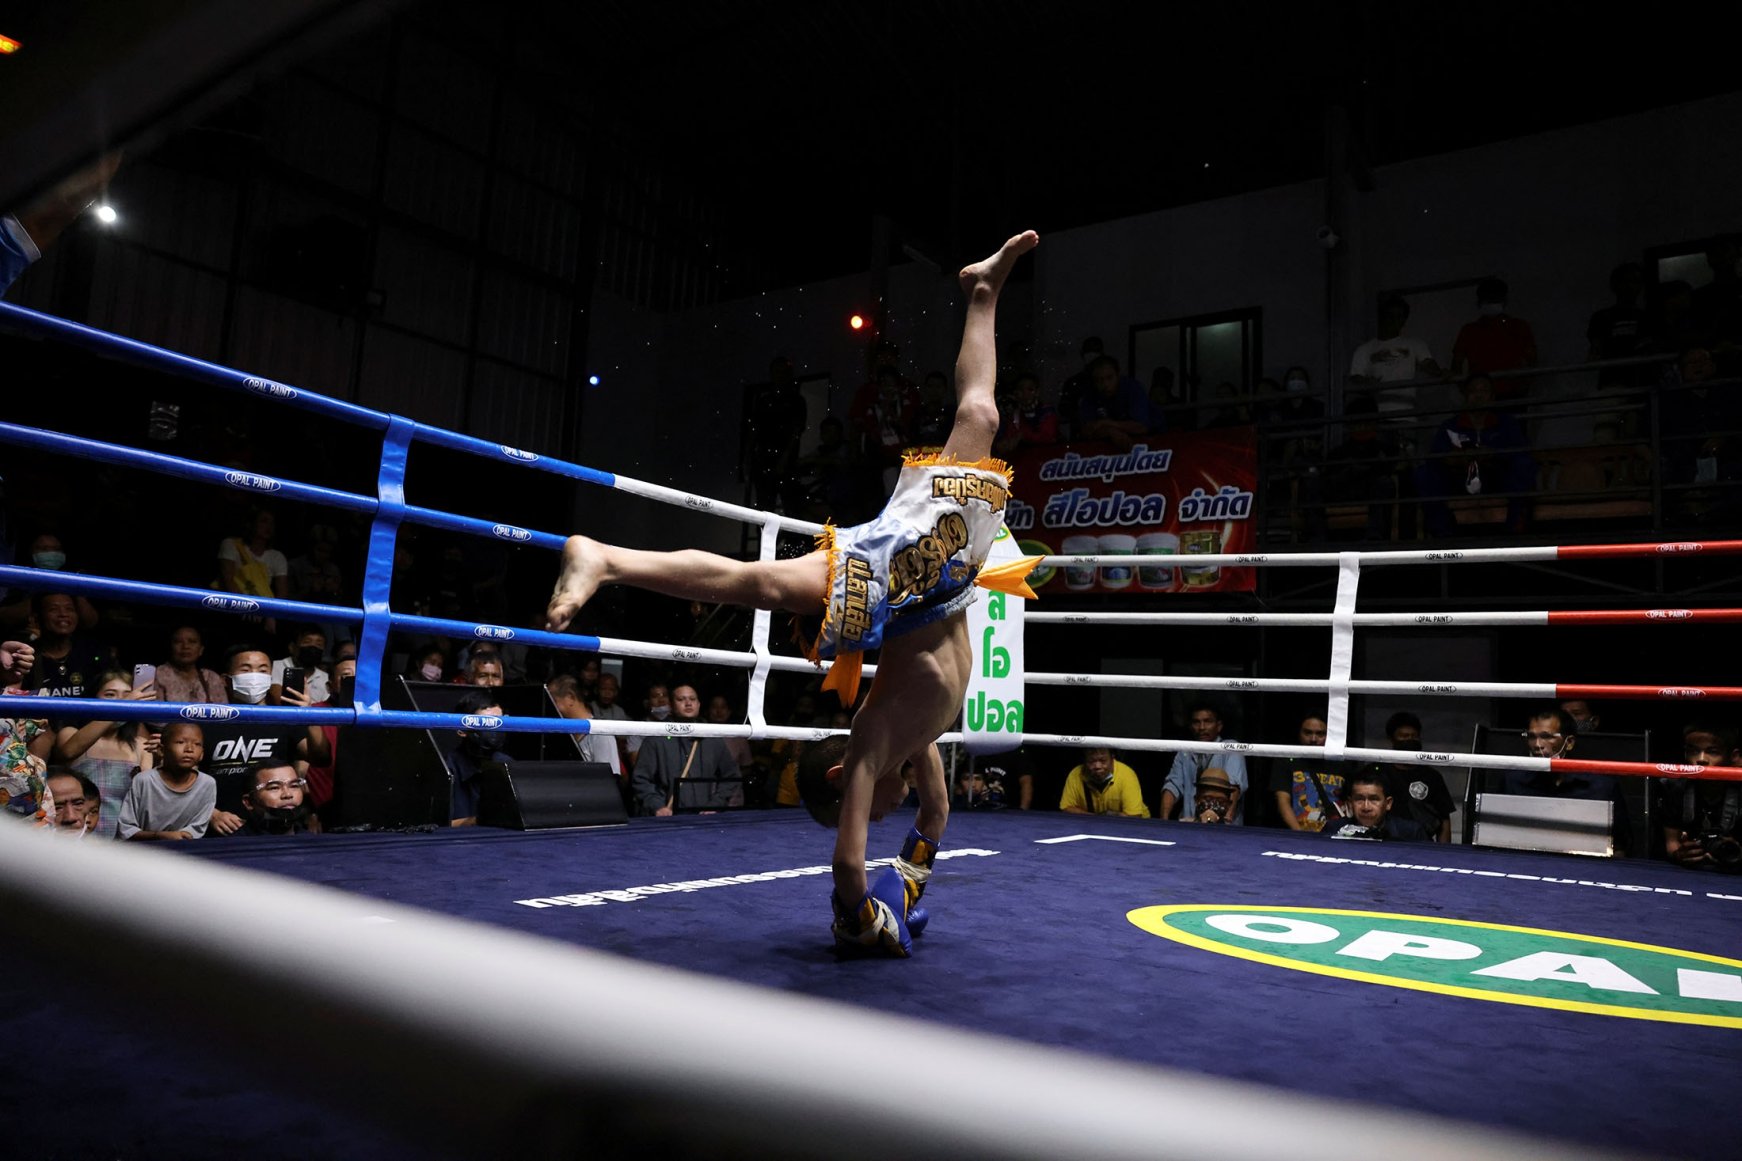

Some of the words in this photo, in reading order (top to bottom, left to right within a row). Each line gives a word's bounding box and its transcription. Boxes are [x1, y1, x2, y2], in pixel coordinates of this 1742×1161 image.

[248, 379, 267, 392] OPAL
[270, 385, 291, 398] PAINT
[231, 473, 250, 486] OPAL
[253, 477, 275, 490] PAINT
[1043, 488, 1166, 528] สีโอปอล
[1179, 486, 1253, 522] จำกัด
[497, 526, 510, 537] OPAL
[512, 528, 528, 540] PAINT
[1678, 543, 1697, 551] PAINT
[208, 597, 228, 608] OPAL
[231, 600, 254, 611] PAINT
[1650, 609, 1666, 617] OPAL
[1669, 609, 1687, 617] PAINT
[478, 626, 492, 637] OPAL
[494, 628, 510, 639] PAINT
[983, 626, 1010, 678] โอ
[186, 707, 207, 718] OPAL
[210, 707, 233, 718] PAINT
[967, 692, 1024, 733] ปอล
[465, 716, 480, 726] OPAL
[482, 716, 499, 727] PAINT
[212, 735, 279, 764] ONE
[1660, 763, 1678, 771] OPAL
[1680, 764, 1700, 772] PAINT
